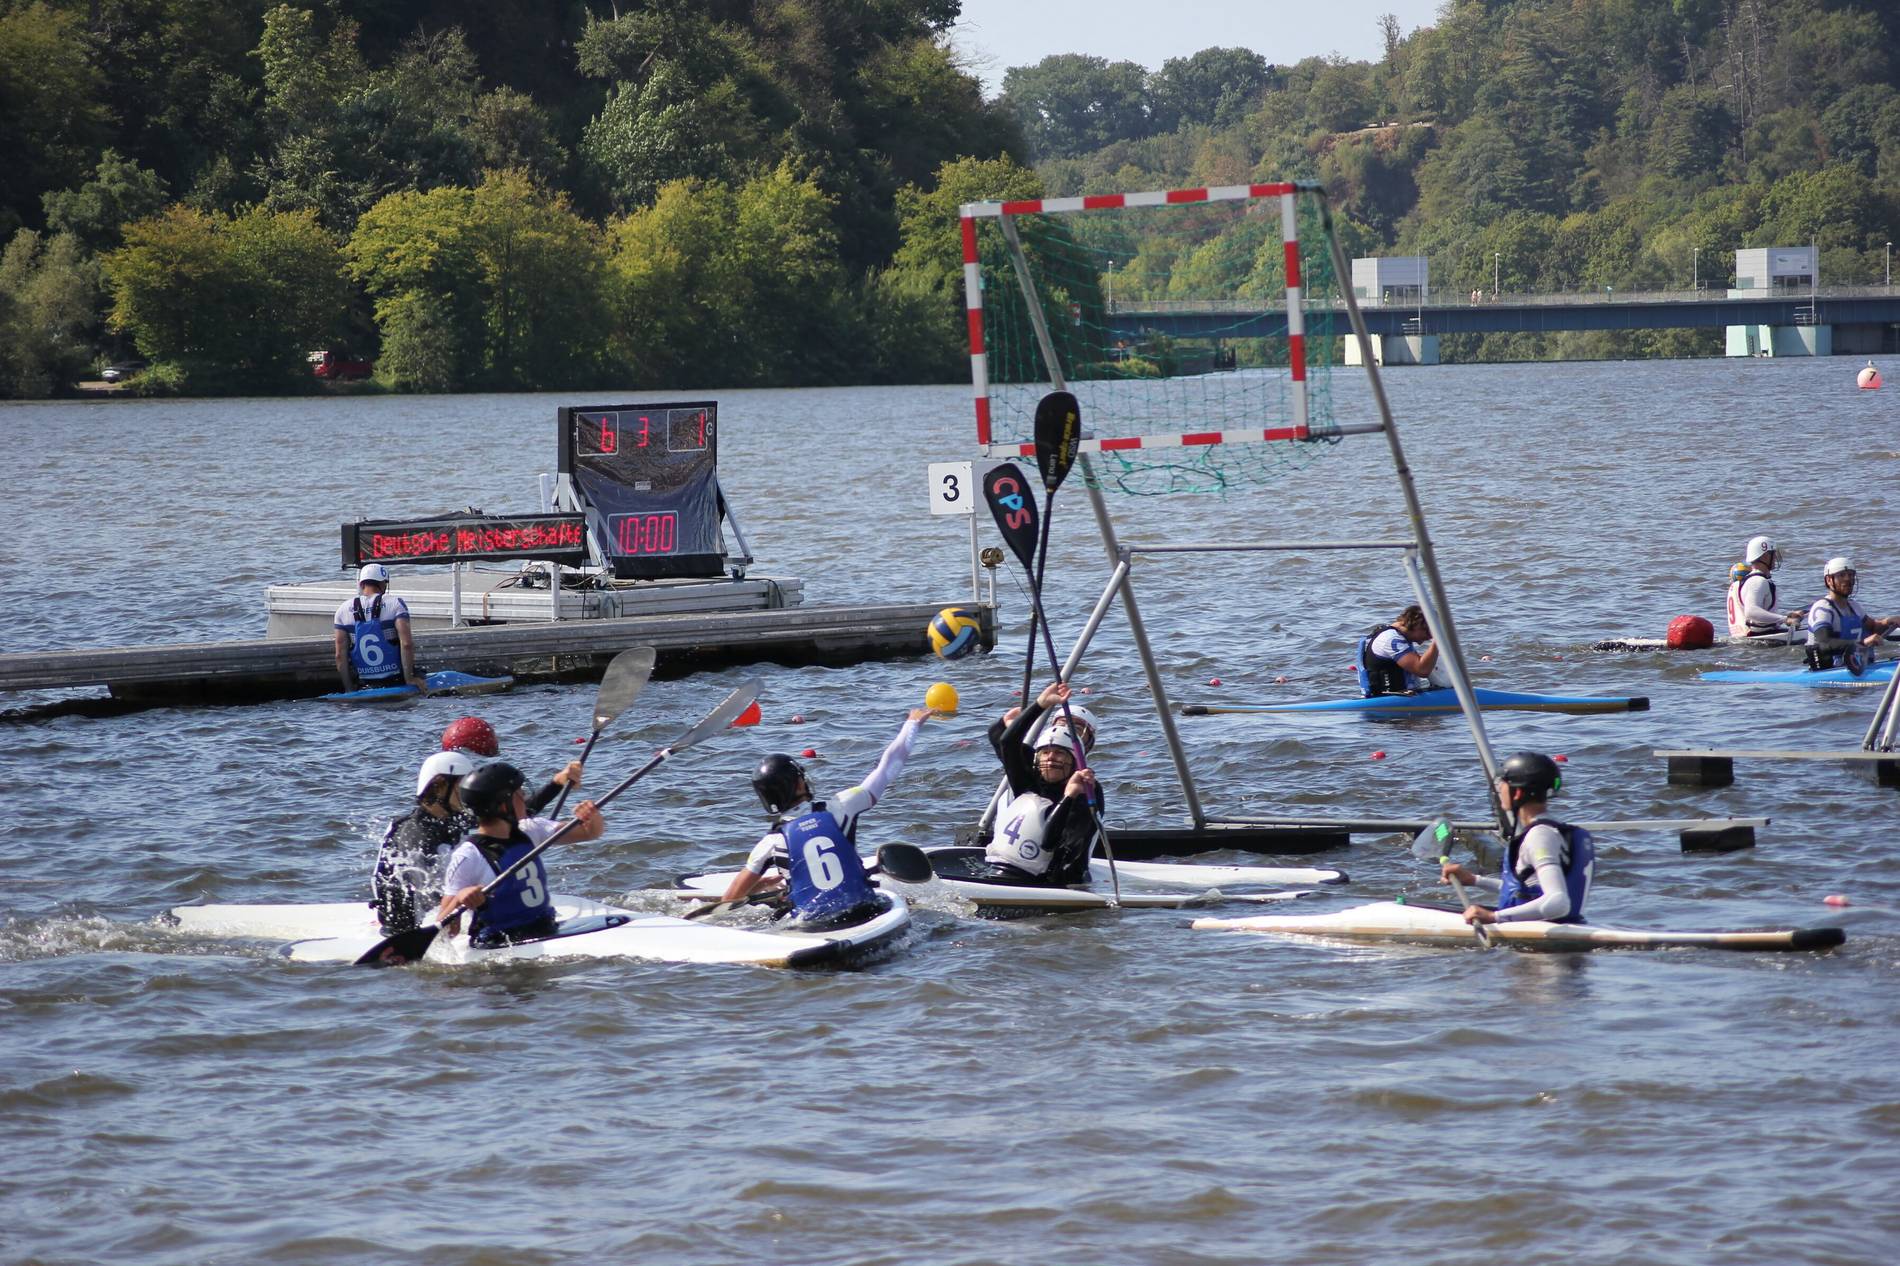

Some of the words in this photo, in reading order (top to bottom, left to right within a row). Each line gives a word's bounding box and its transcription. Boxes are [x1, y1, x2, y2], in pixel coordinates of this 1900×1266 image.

[1869, 370, 1877, 381] 7
[637, 416, 649, 448] 3
[698, 411, 705, 446] 1
[943, 474, 960, 502] 3
[993, 477, 1032, 530] CPS
[371, 532, 449, 558] Deutsche
[618, 515, 674, 554] 10:00
[1761, 542, 1768, 551] 9
[380, 567, 387, 577] 6
[1728, 597, 1736, 625] 9
[360, 634, 384, 667] 6
[357, 663, 398, 675] DUISBURG
[1003, 815, 1026, 846] 4
[803, 836, 844, 890] 6
[515, 860, 545, 908] 3
